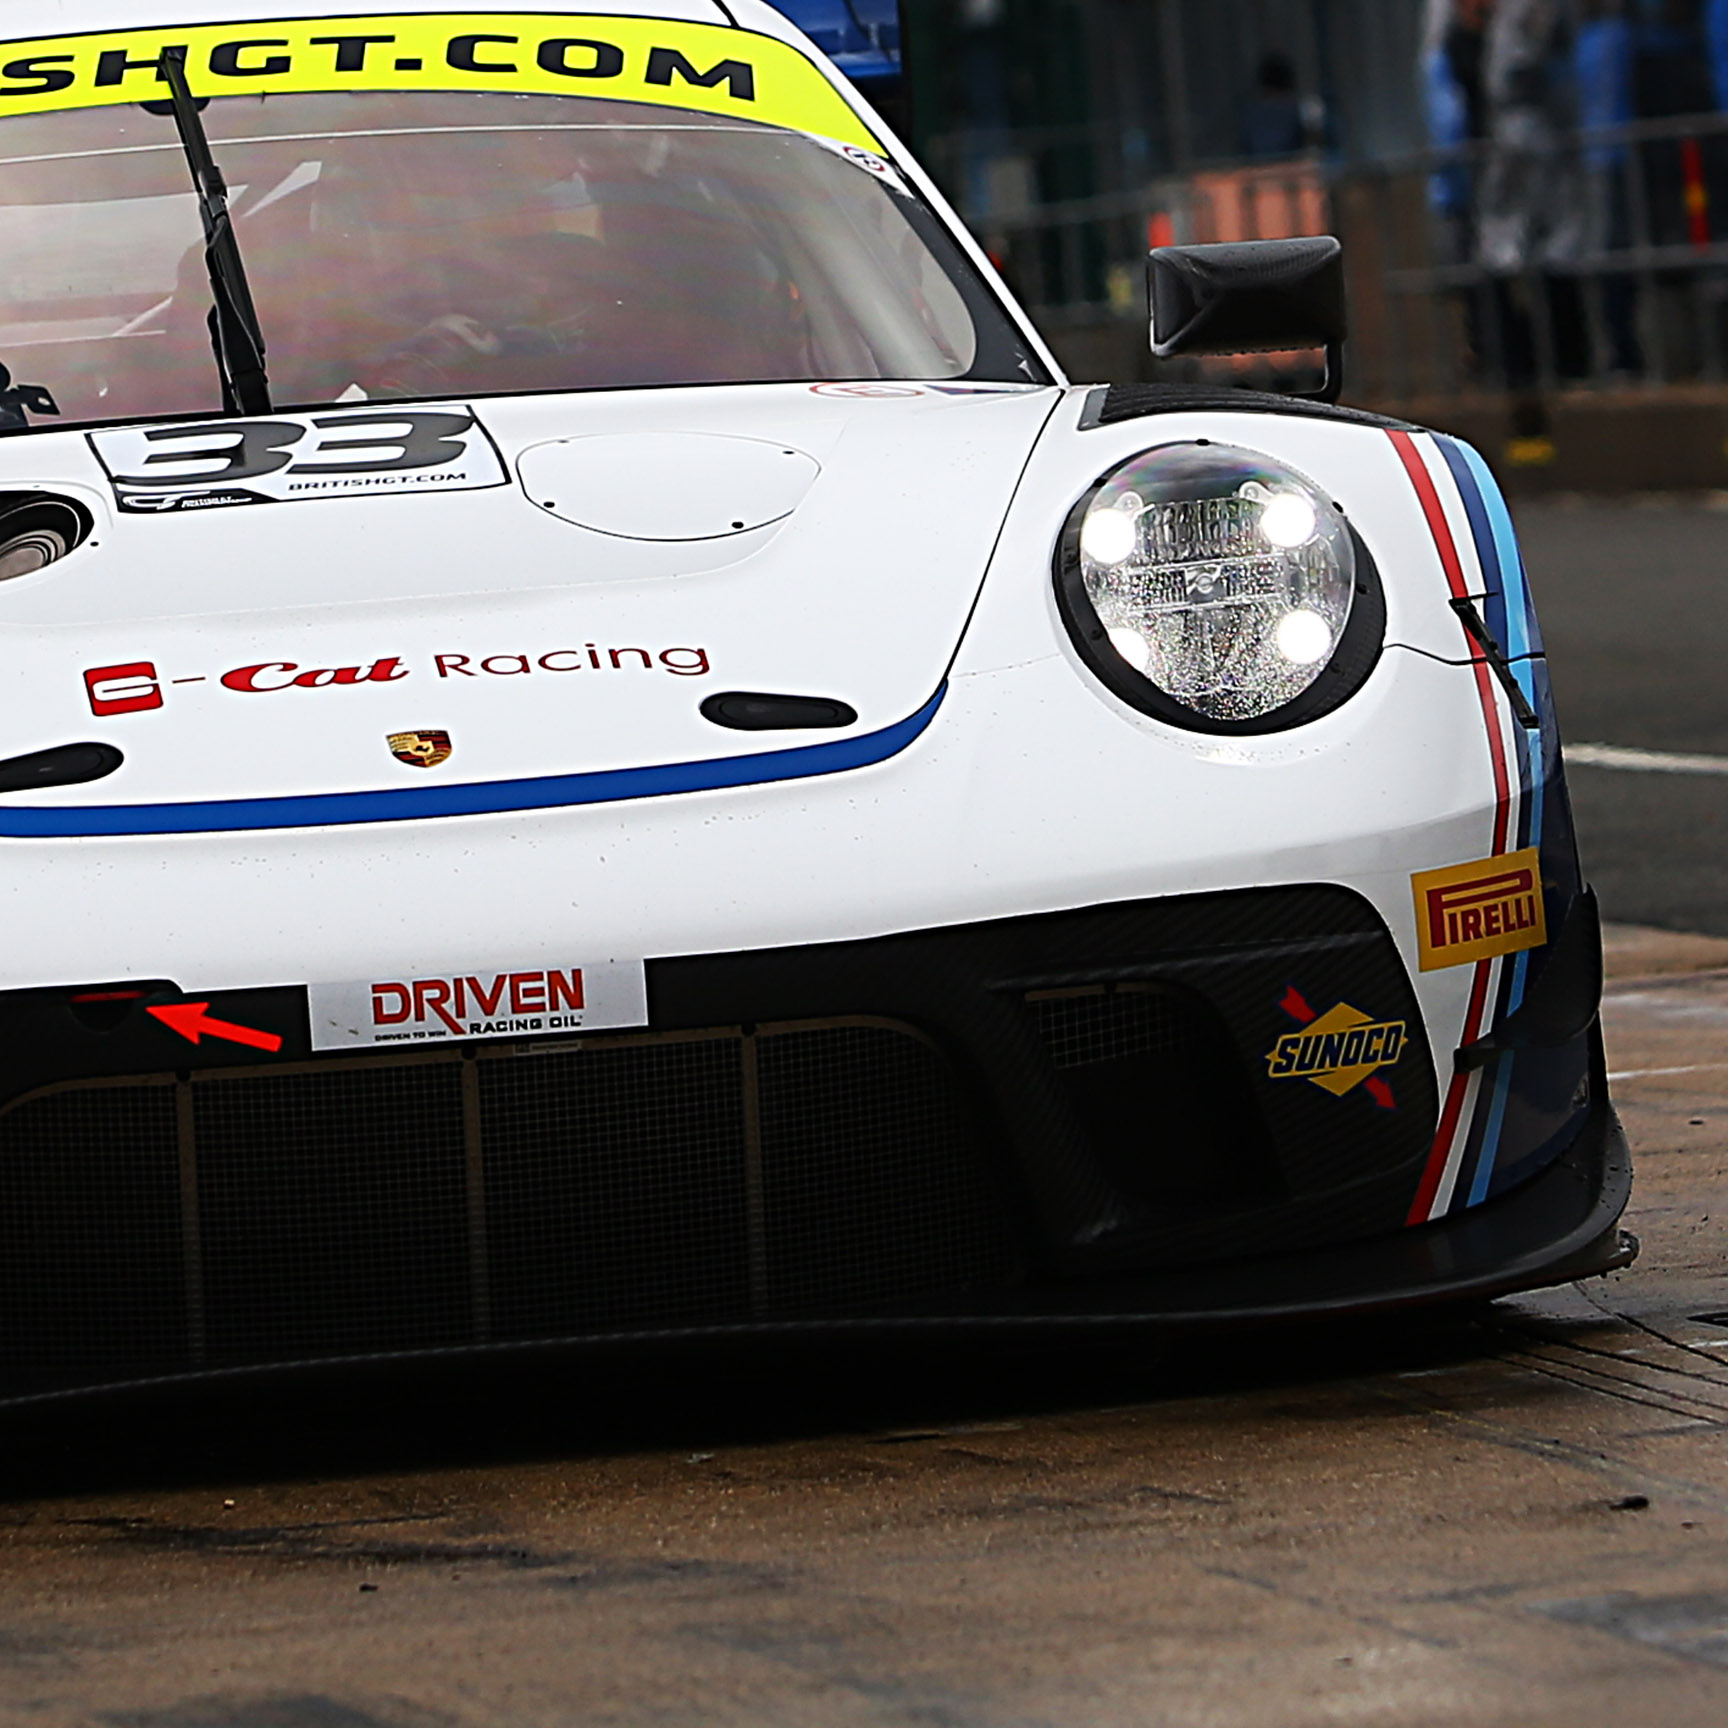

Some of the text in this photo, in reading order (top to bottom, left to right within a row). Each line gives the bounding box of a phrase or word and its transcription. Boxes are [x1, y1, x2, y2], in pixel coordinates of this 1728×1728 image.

[115, 412, 475, 487] 33
[288, 471, 468, 492] BRITISHGT.COM
[433, 642, 711, 678] Racing
[1426, 868, 1536, 948] PIRELLI
[371, 968, 585, 1035] DRIVEN
[413, 1031, 425, 1039] TO
[469, 1014, 583, 1035] RACING OIL
[1273, 1024, 1405, 1074] SUNOCO
